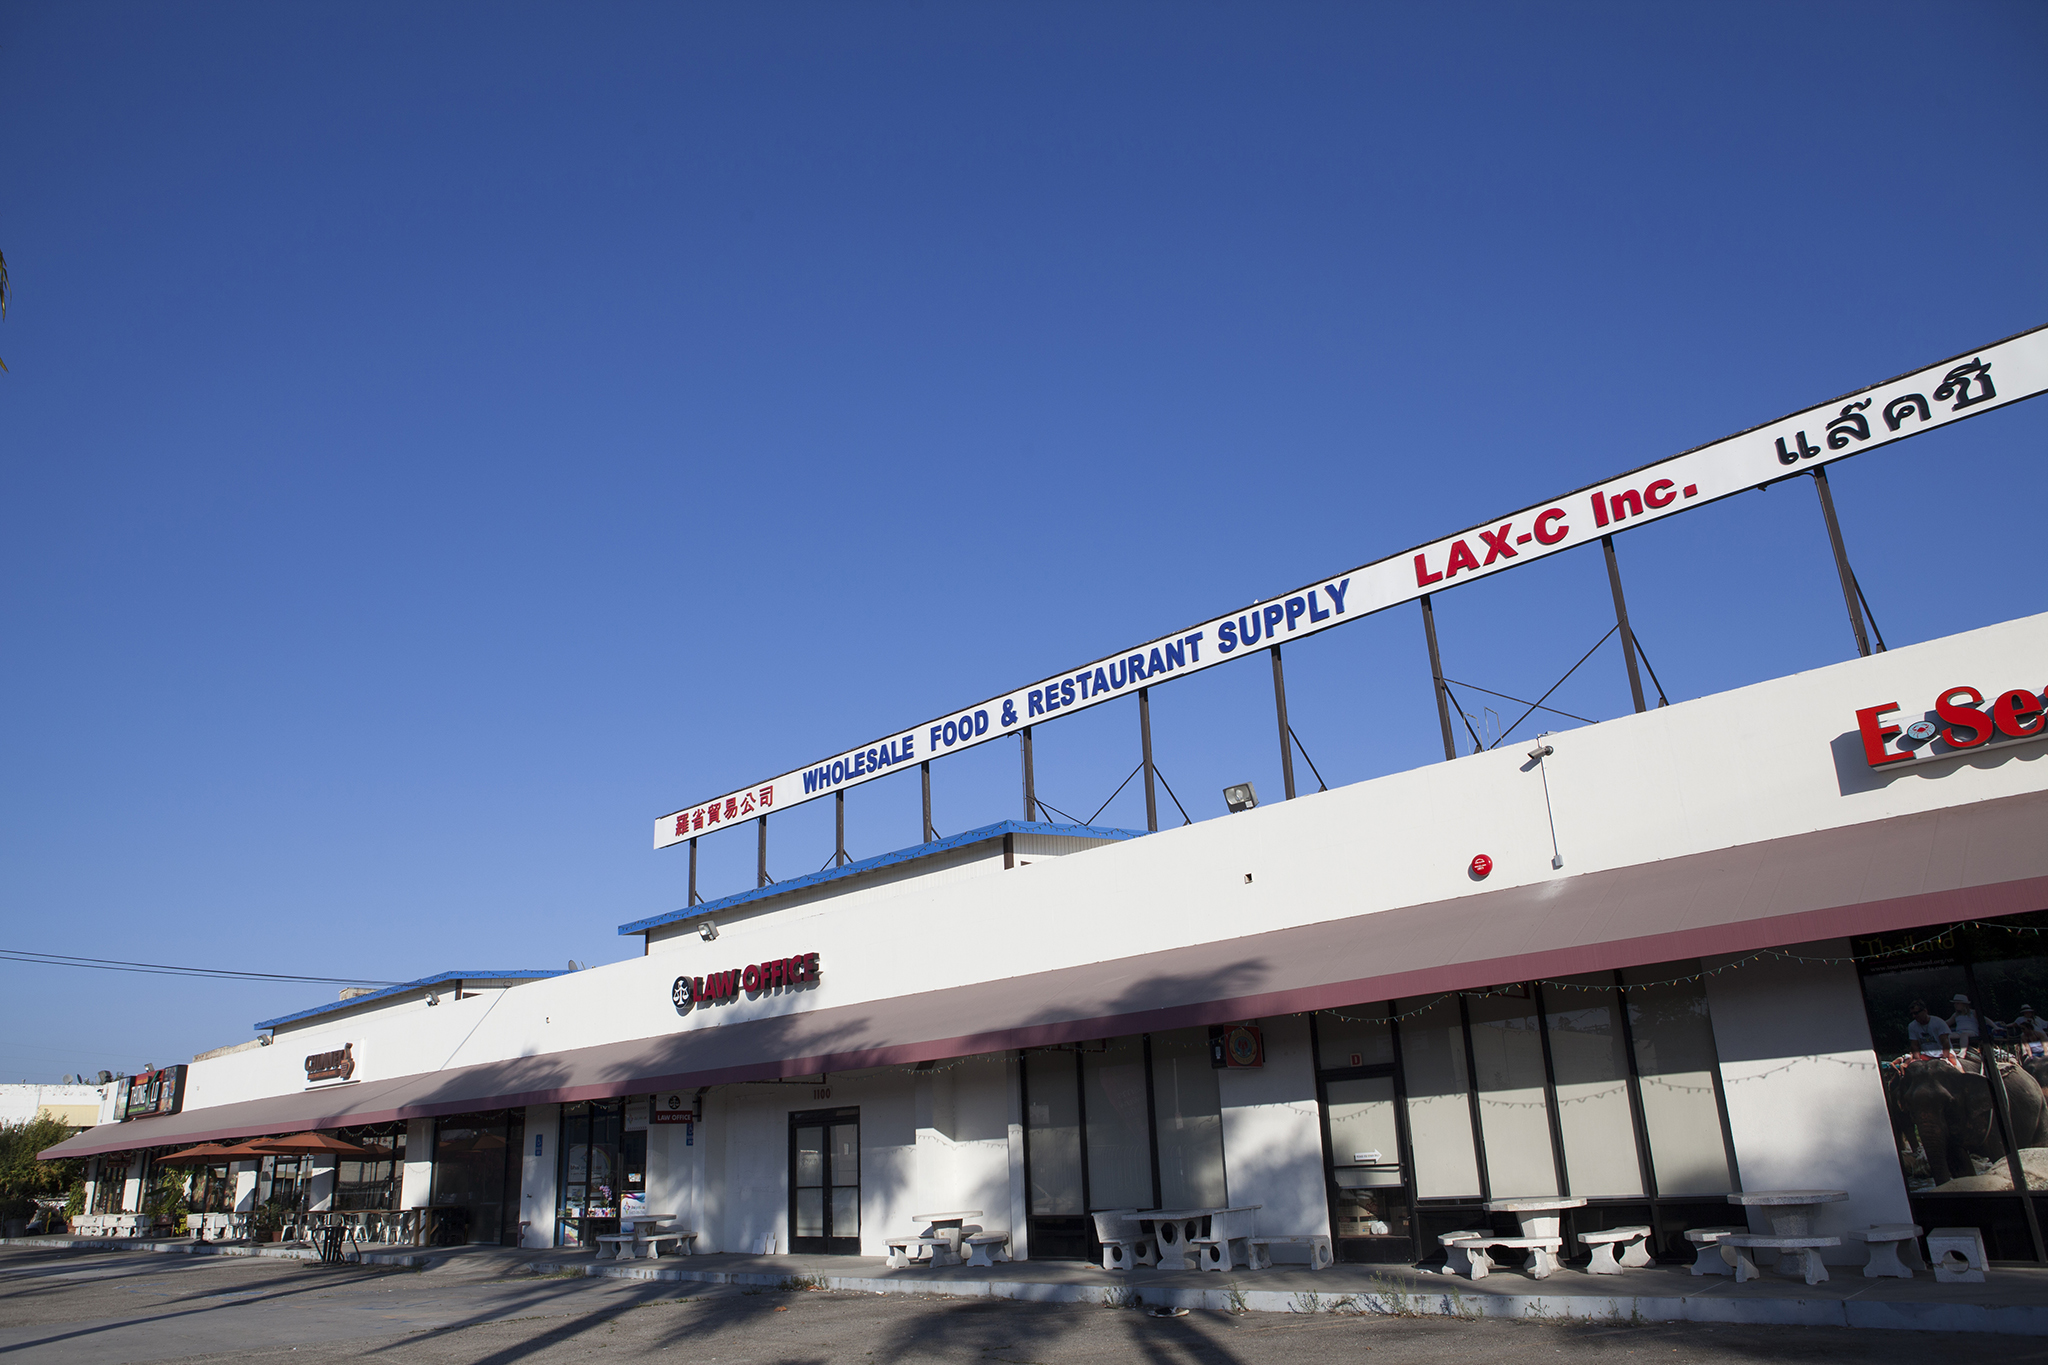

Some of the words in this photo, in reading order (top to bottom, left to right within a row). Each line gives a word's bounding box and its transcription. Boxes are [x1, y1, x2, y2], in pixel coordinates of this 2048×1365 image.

[1413, 507, 1570, 588] LAX-C
[1590, 478, 1699, 528] Inc.
[802, 734, 914, 795] WHOLESALE
[930, 709, 989, 751] FOOD
[1001, 698, 1018, 726] &
[1028, 631, 1203, 718] RESTAURANT
[1217, 578, 1350, 654] SUPPLY
[1934, 685, 2048, 749] Se
[675, 784, 775, 837] 羅省貿易公司
[1859, 930, 1955, 958] Thailand
[693, 968, 738, 1002] LAW
[742, 952, 817, 993] OFFICE
[1351, 1054, 1360, 1065] D
[671, 1113, 691, 1121] OFFICE
[813, 1088, 831, 1099] 1100
